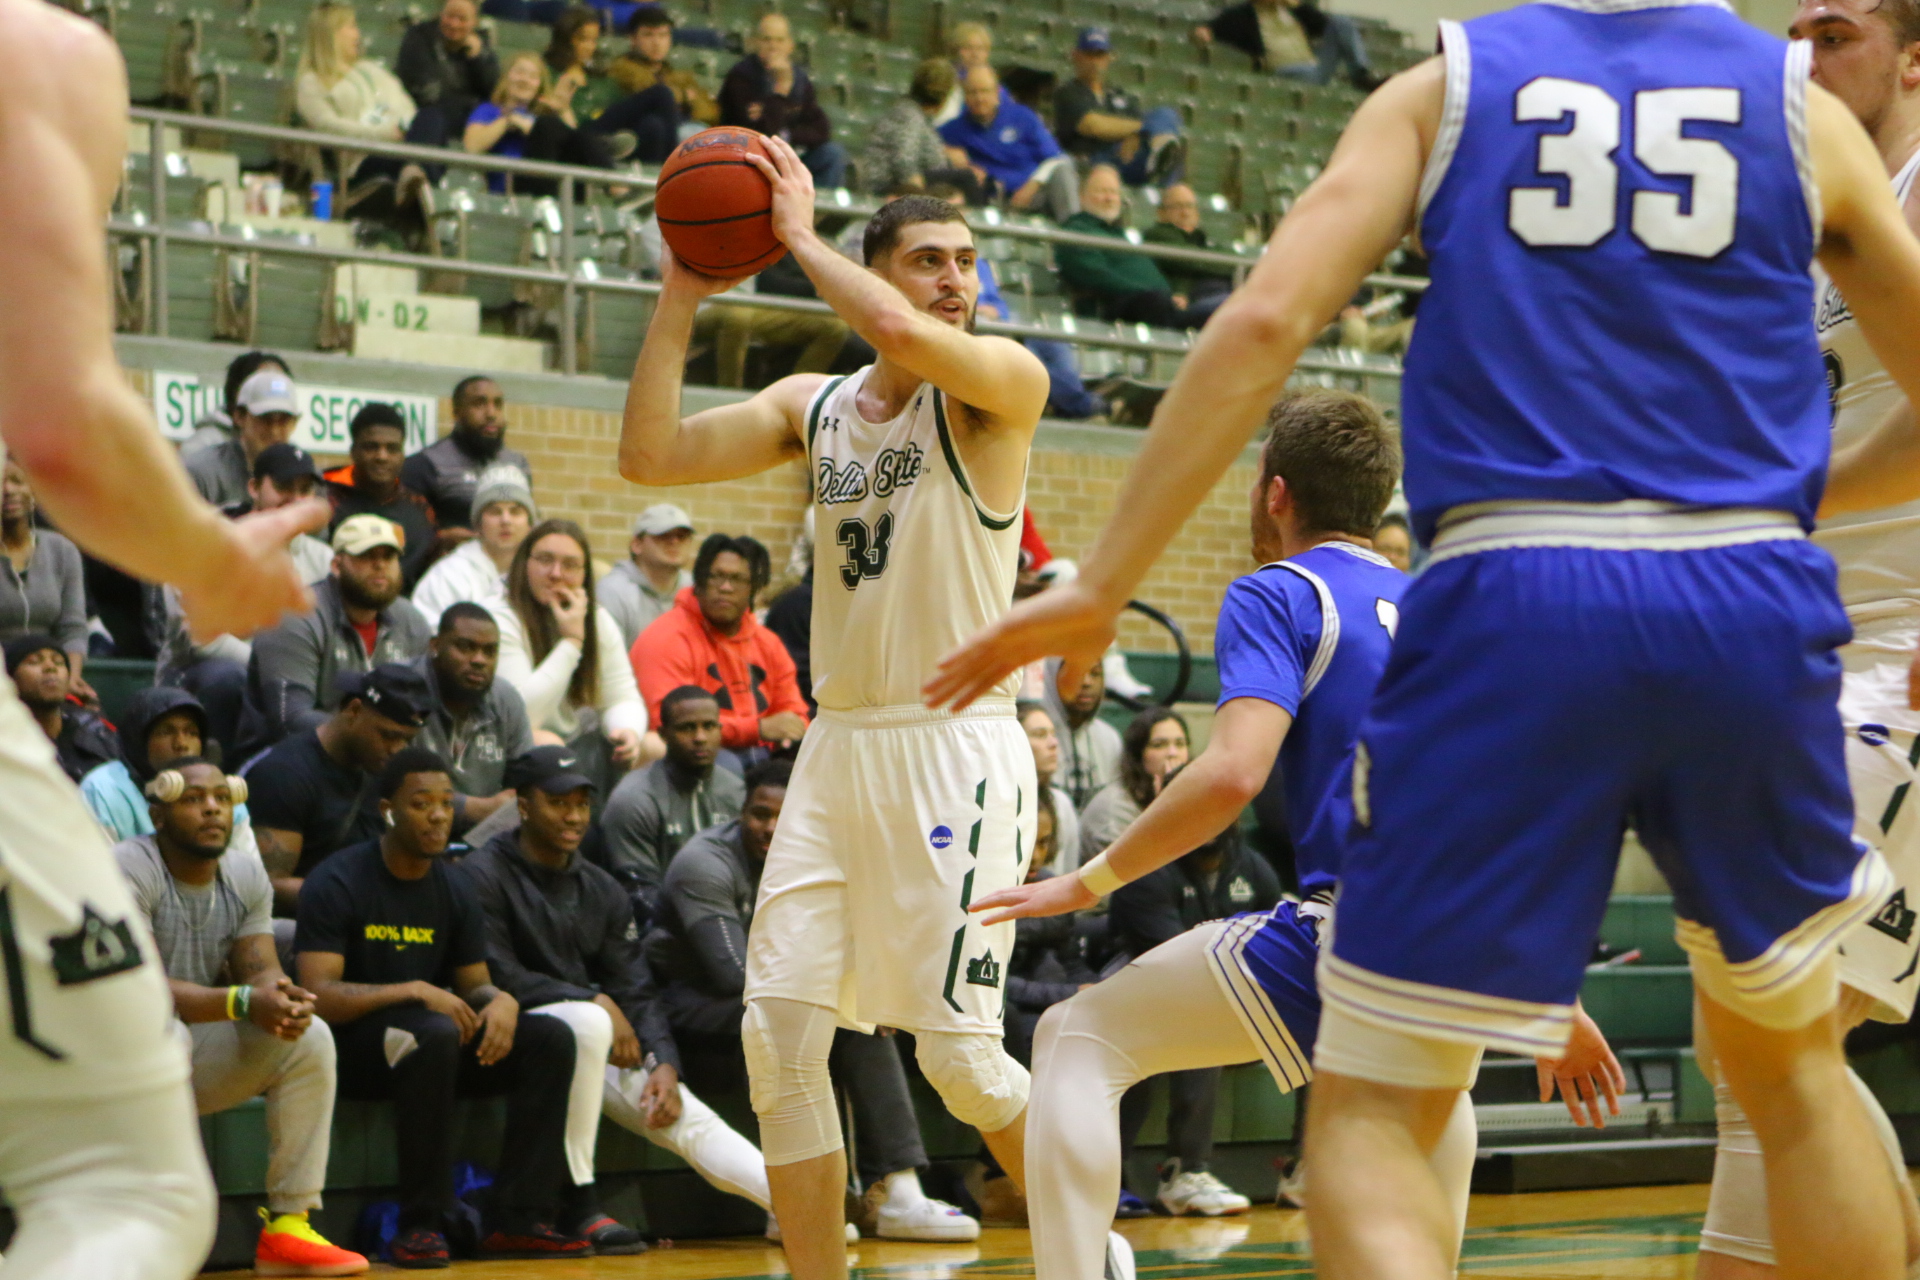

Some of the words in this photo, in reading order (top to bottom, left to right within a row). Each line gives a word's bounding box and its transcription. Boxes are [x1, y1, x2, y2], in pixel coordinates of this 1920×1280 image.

[1507, 76, 1742, 260] 35
[310, 393, 427, 448] SECON
[817, 457, 868, 505] Delta
[836, 510, 894, 591] 33
[365, 924, 400, 940] 100%
